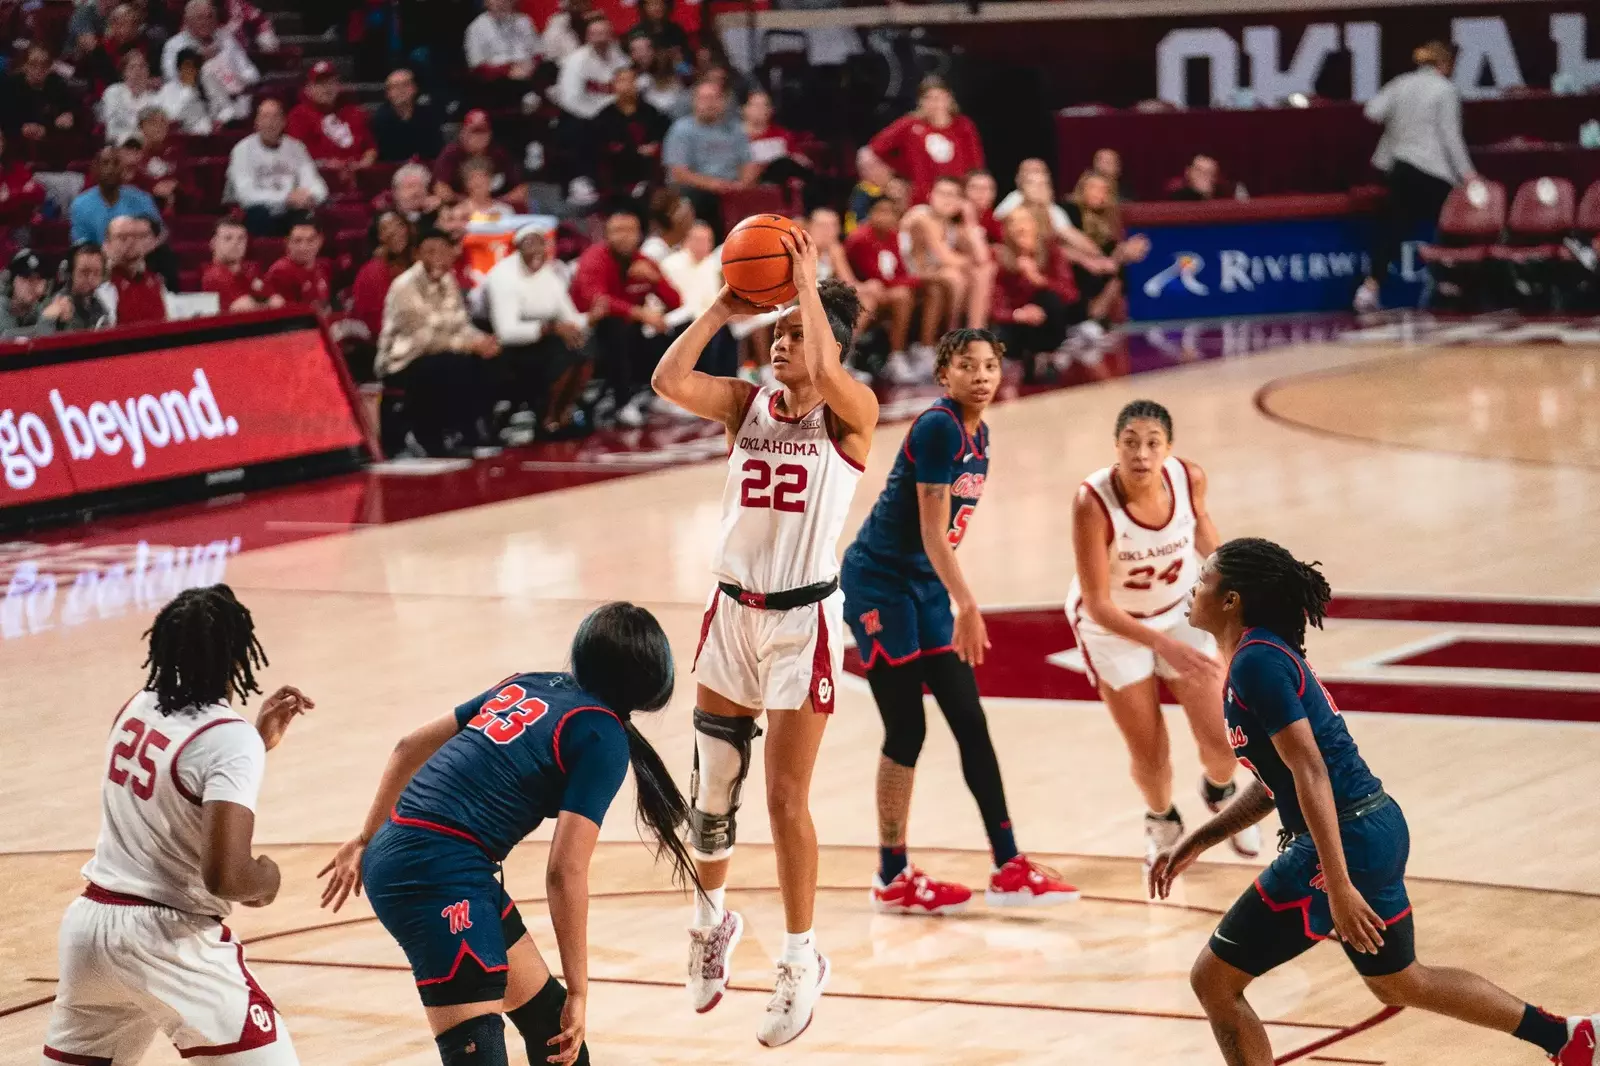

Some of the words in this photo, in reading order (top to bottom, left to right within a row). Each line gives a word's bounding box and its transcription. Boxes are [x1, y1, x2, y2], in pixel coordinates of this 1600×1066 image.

[0, 408, 53, 490] go
[49, 367, 239, 469] beyond.
[740, 437, 819, 457] OKLAHOMA
[740, 458, 808, 513] 22
[946, 503, 975, 548] 5
[1118, 536, 1189, 561] OKLAHOMA
[1123, 557, 1184, 590] 24
[818, 677, 833, 704] OU
[466, 683, 550, 744] 23
[108, 716, 172, 801] 25
[441, 899, 473, 935] M
[249, 1004, 273, 1032] OU
